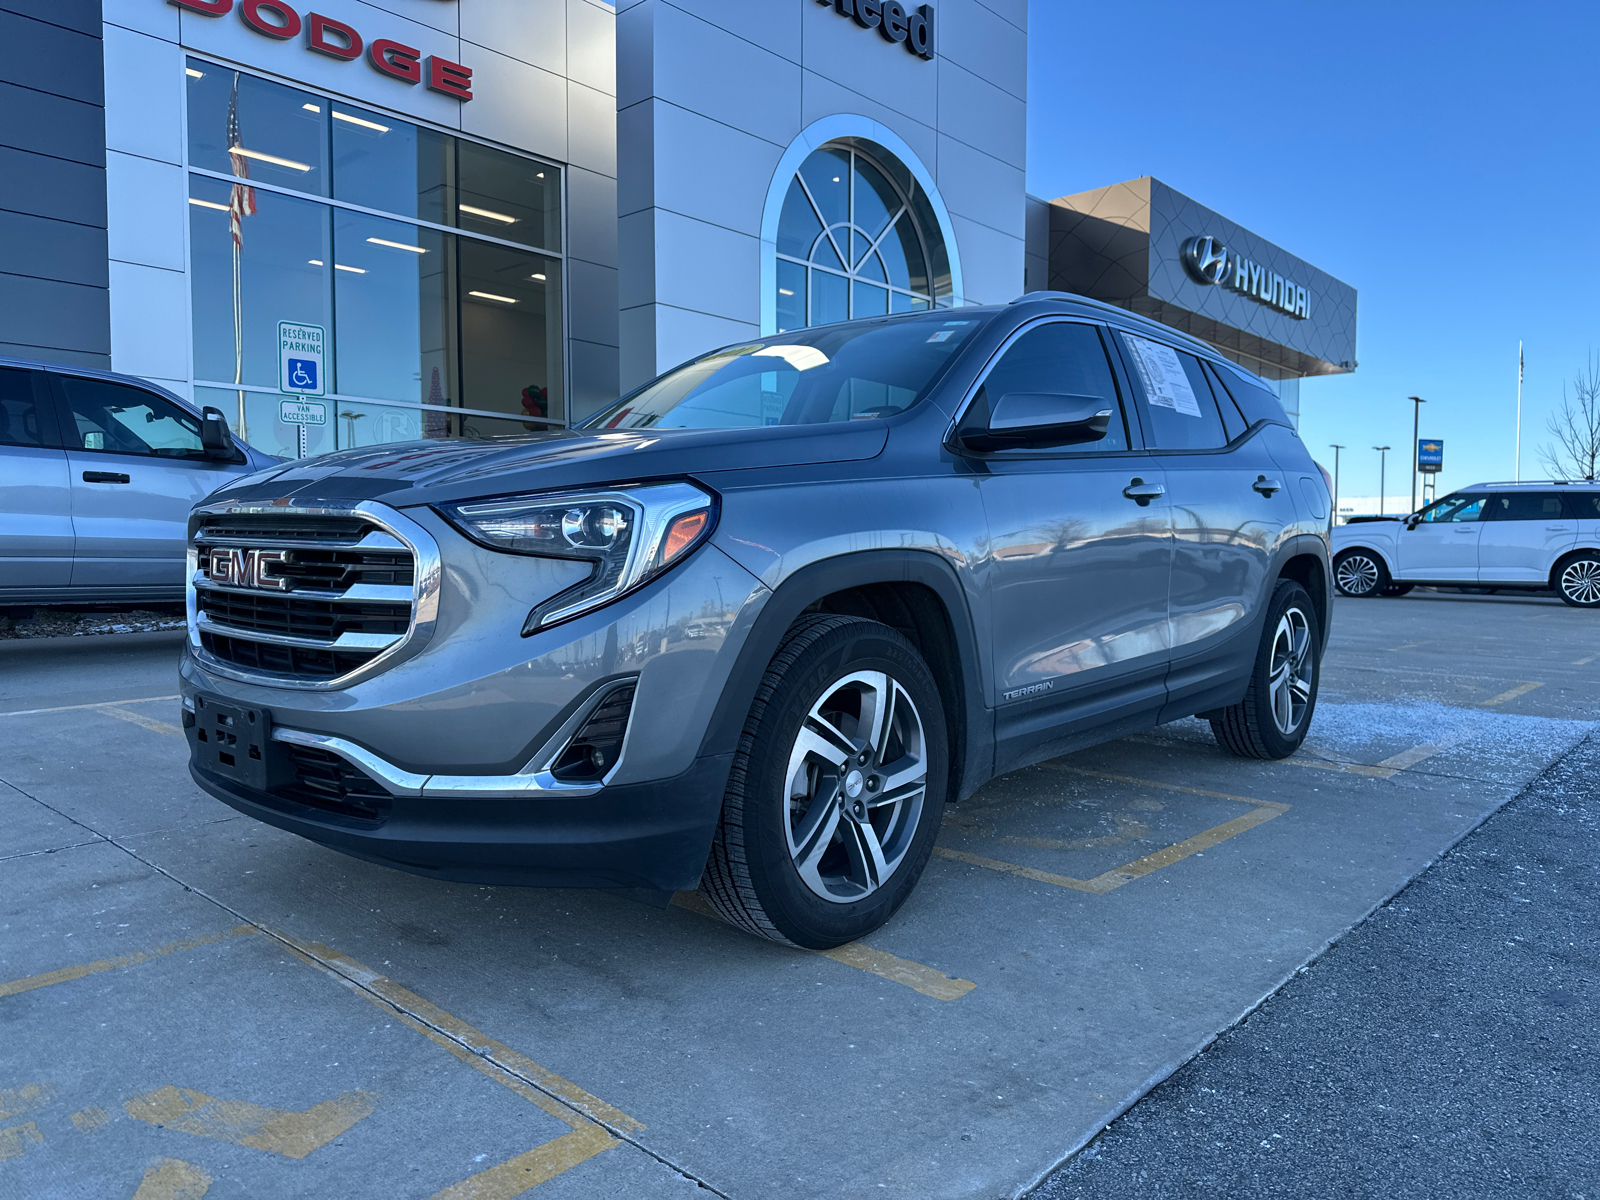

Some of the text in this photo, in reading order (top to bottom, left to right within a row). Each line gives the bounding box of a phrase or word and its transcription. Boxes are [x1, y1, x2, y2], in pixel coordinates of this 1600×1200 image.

[816, 0, 935, 61] eed
[1234, 254, 1311, 320] HYUNDAI
[282, 328, 321, 342] RESERVED
[282, 340, 321, 354] PARKING
[283, 412, 324, 422] ACCESSIBLE
[297, 405, 310, 413] VAN
[210, 548, 287, 590] GMC
[1002, 680, 1054, 700] TERRAIN
